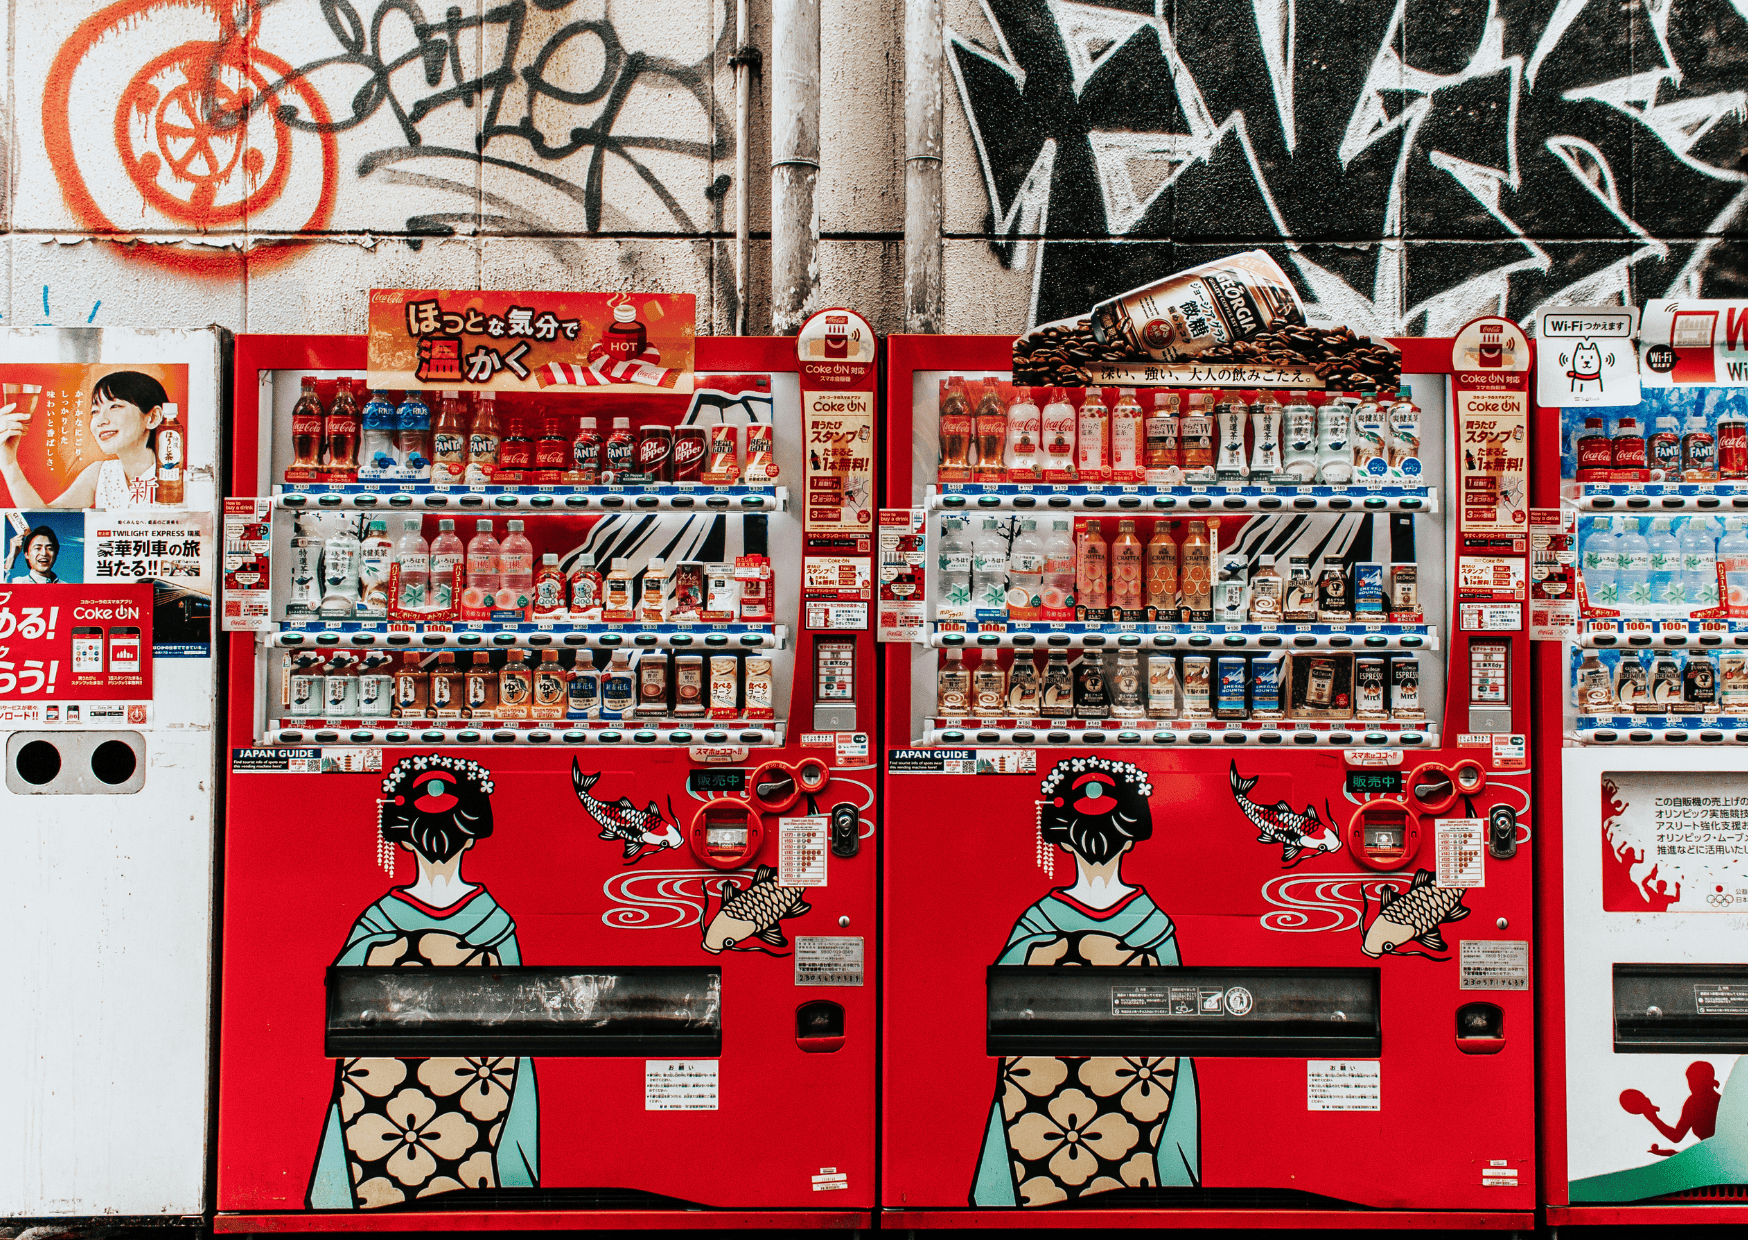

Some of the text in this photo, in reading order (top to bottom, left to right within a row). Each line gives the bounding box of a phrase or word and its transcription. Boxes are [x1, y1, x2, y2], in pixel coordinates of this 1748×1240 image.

[371, 292, 404, 304] Coca-Cola
[1216, 273, 1257, 335] GEORGIA
[408, 302, 580, 340] ほっとな気分で
[1180, 300, 1210, 338] 微糖
[1551, 320, 1624, 332] Wi-Fiつかえます
[610, 342, 638, 352] HOT
[416, 337, 531, 382] 温かく
[1650, 352, 1672, 362] Wi-Fi
[806, 364, 832, 374] Coke
[1101, 366, 1313, 384] 深い、強い、大人の飲みごたえ。
[1460, 374, 1487, 383] Coke
[813, 402, 845, 412] Coke
[1468, 402, 1499, 412] Coke
[61, 390, 69, 444] しっかりした
[47, 390, 55, 471] 味わいと香ばしさ。
[75, 390, 84, 461] かすかなにごり。
[292, 420, 321, 433] Coca-Cola
[328, 420, 356, 433] Coca-Cola
[942, 420, 970, 433] Coca-Cola
[978, 421, 1005, 433] Coca-Cola
[1010, 418, 1040, 432] Coca-Cola
[1044, 418, 1074, 432] Coca-Cola
[1166, 424, 1176, 434] W
[1200, 424, 1212, 434] W
[810, 430, 858, 444] スタンプ
[1465, 430, 1512, 444] スタンプ
[434, 440, 461, 452] FANTA
[470, 440, 496, 452] FANTA
[607, 446, 632, 458] FANTA
[647, 442, 659, 450] Dr
[682, 442, 694, 450] Dr
[750, 444, 770, 452] GOLD
[823, 448, 854, 456] たまると
[1478, 448, 1508, 456] たまると
[1654, 446, 1679, 458] FANT
[1690, 446, 1714, 458] FANT
[501, 452, 529, 465] Coca-Cola
[536, 451, 564, 464] Coca-Cola
[574, 446, 598, 459] FANTA
[640, 446, 666, 462] Pepper
[675, 446, 701, 462] Pepper
[822, 458, 870, 472] 1本無料!
[1478, 458, 1524, 472] 1本無料!
[130, 476, 158, 504] 新
[97, 540, 201, 557] 豪華列車の旅
[454, 564, 462, 610] バリューコーナー
[1718, 563, 1726, 608] バリューコーナー
[73, 607, 113, 620] Coke
[1590, 622, 1616, 630] 100円
[1625, 622, 1650, 630] 100円
[1662, 622, 1686, 630] 100円
[1700, 622, 1726, 630] 100円
[505, 682, 518, 699] ゆず
[540, 682, 552, 699] ゆず
[712, 682, 732, 690] 食べる
[748, 682, 768, 690] 食べる
[1400, 692, 1417, 700] MILK
[239, 750, 314, 758] JAPAN GUIDE
[895, 750, 968, 758] JAPAN GUIDE
[698, 774, 740, 787] 販売中
[1353, 775, 1394, 788] 販売中
[1655, 797, 1748, 807] この自販機の売上げの
[1655, 809, 1748, 819] オリンピック実施競技
